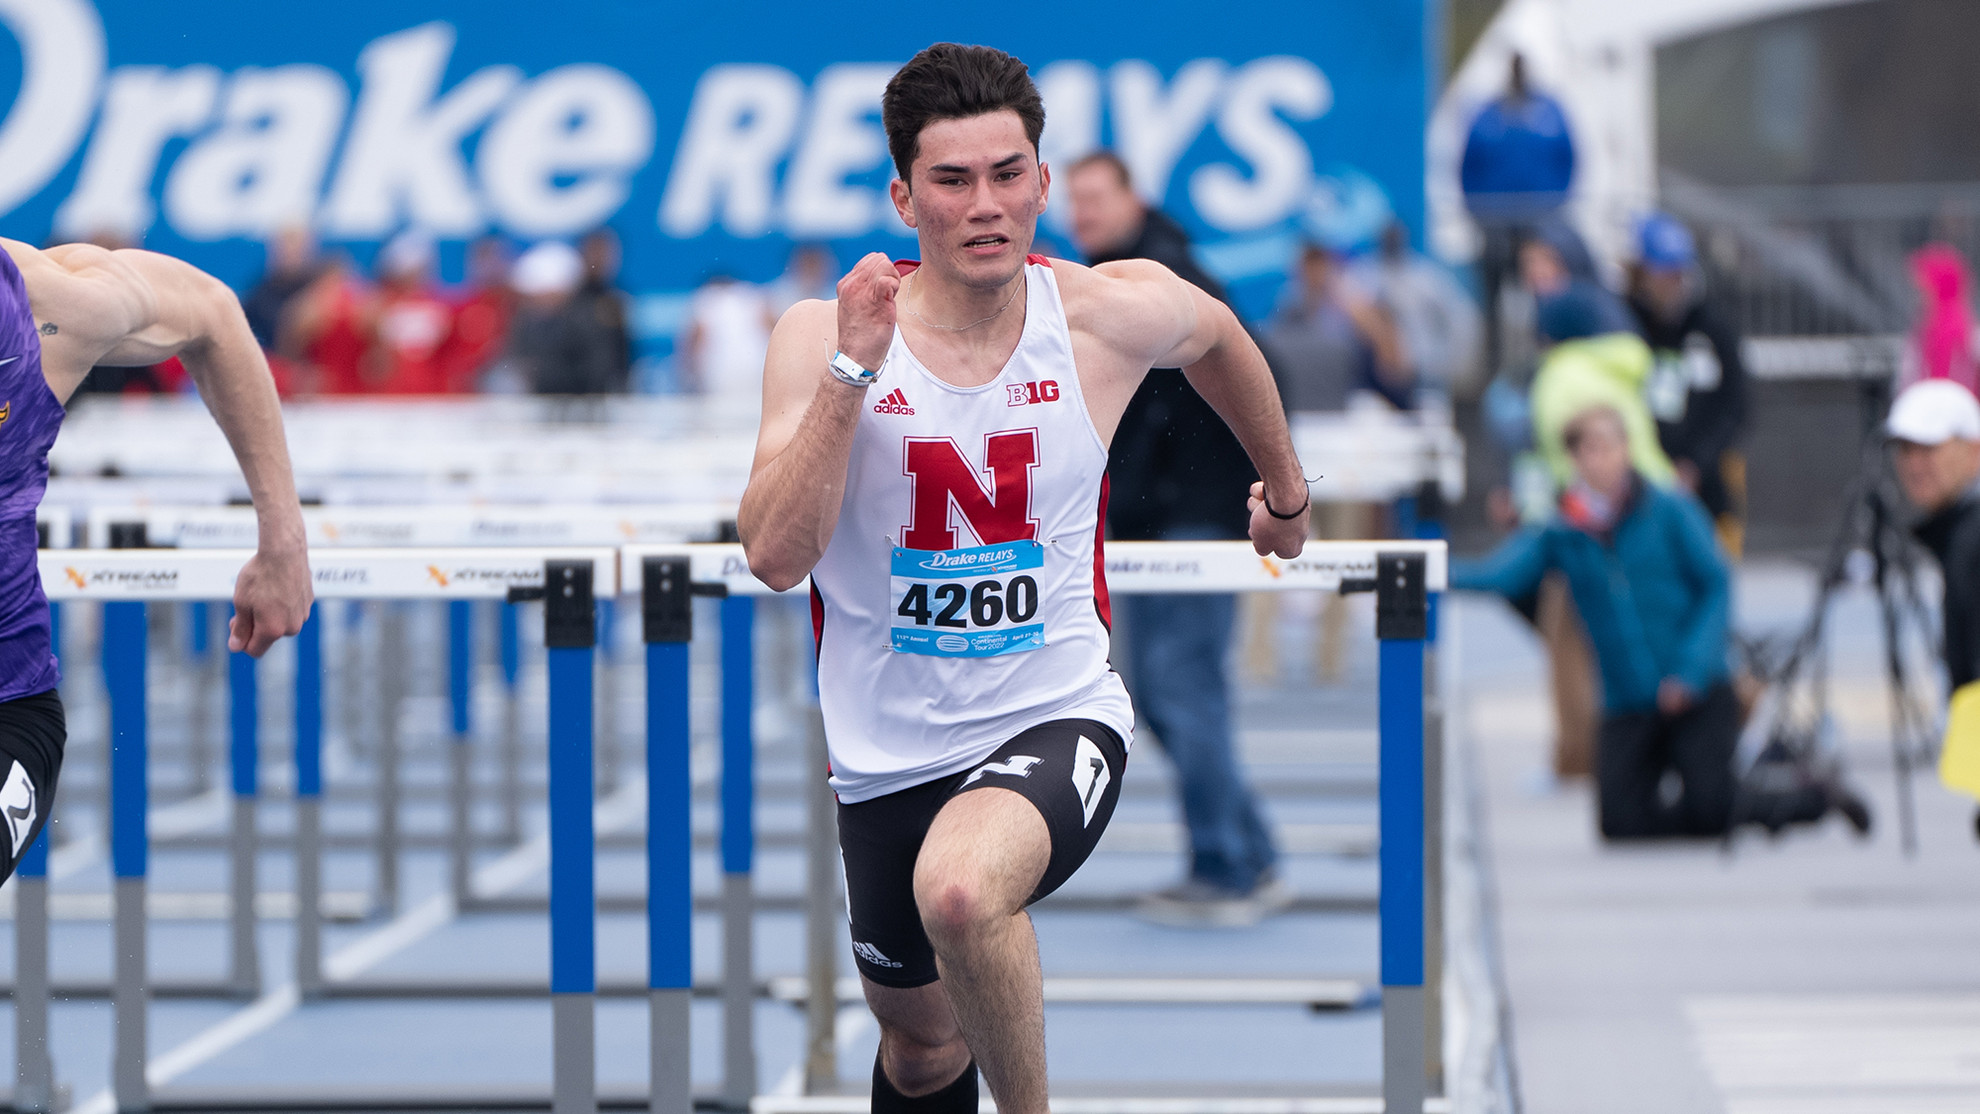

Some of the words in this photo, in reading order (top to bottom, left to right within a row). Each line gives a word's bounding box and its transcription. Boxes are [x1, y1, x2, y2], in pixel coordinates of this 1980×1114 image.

[656, 52, 1334, 240] REAYS
[873, 404, 916, 416] adidas
[900, 427, 1042, 549] N
[930, 552, 977, 568] Drake
[977, 549, 1014, 563] RELAYS
[897, 575, 1038, 628] 4260
[971, 636, 1008, 645] Continental
